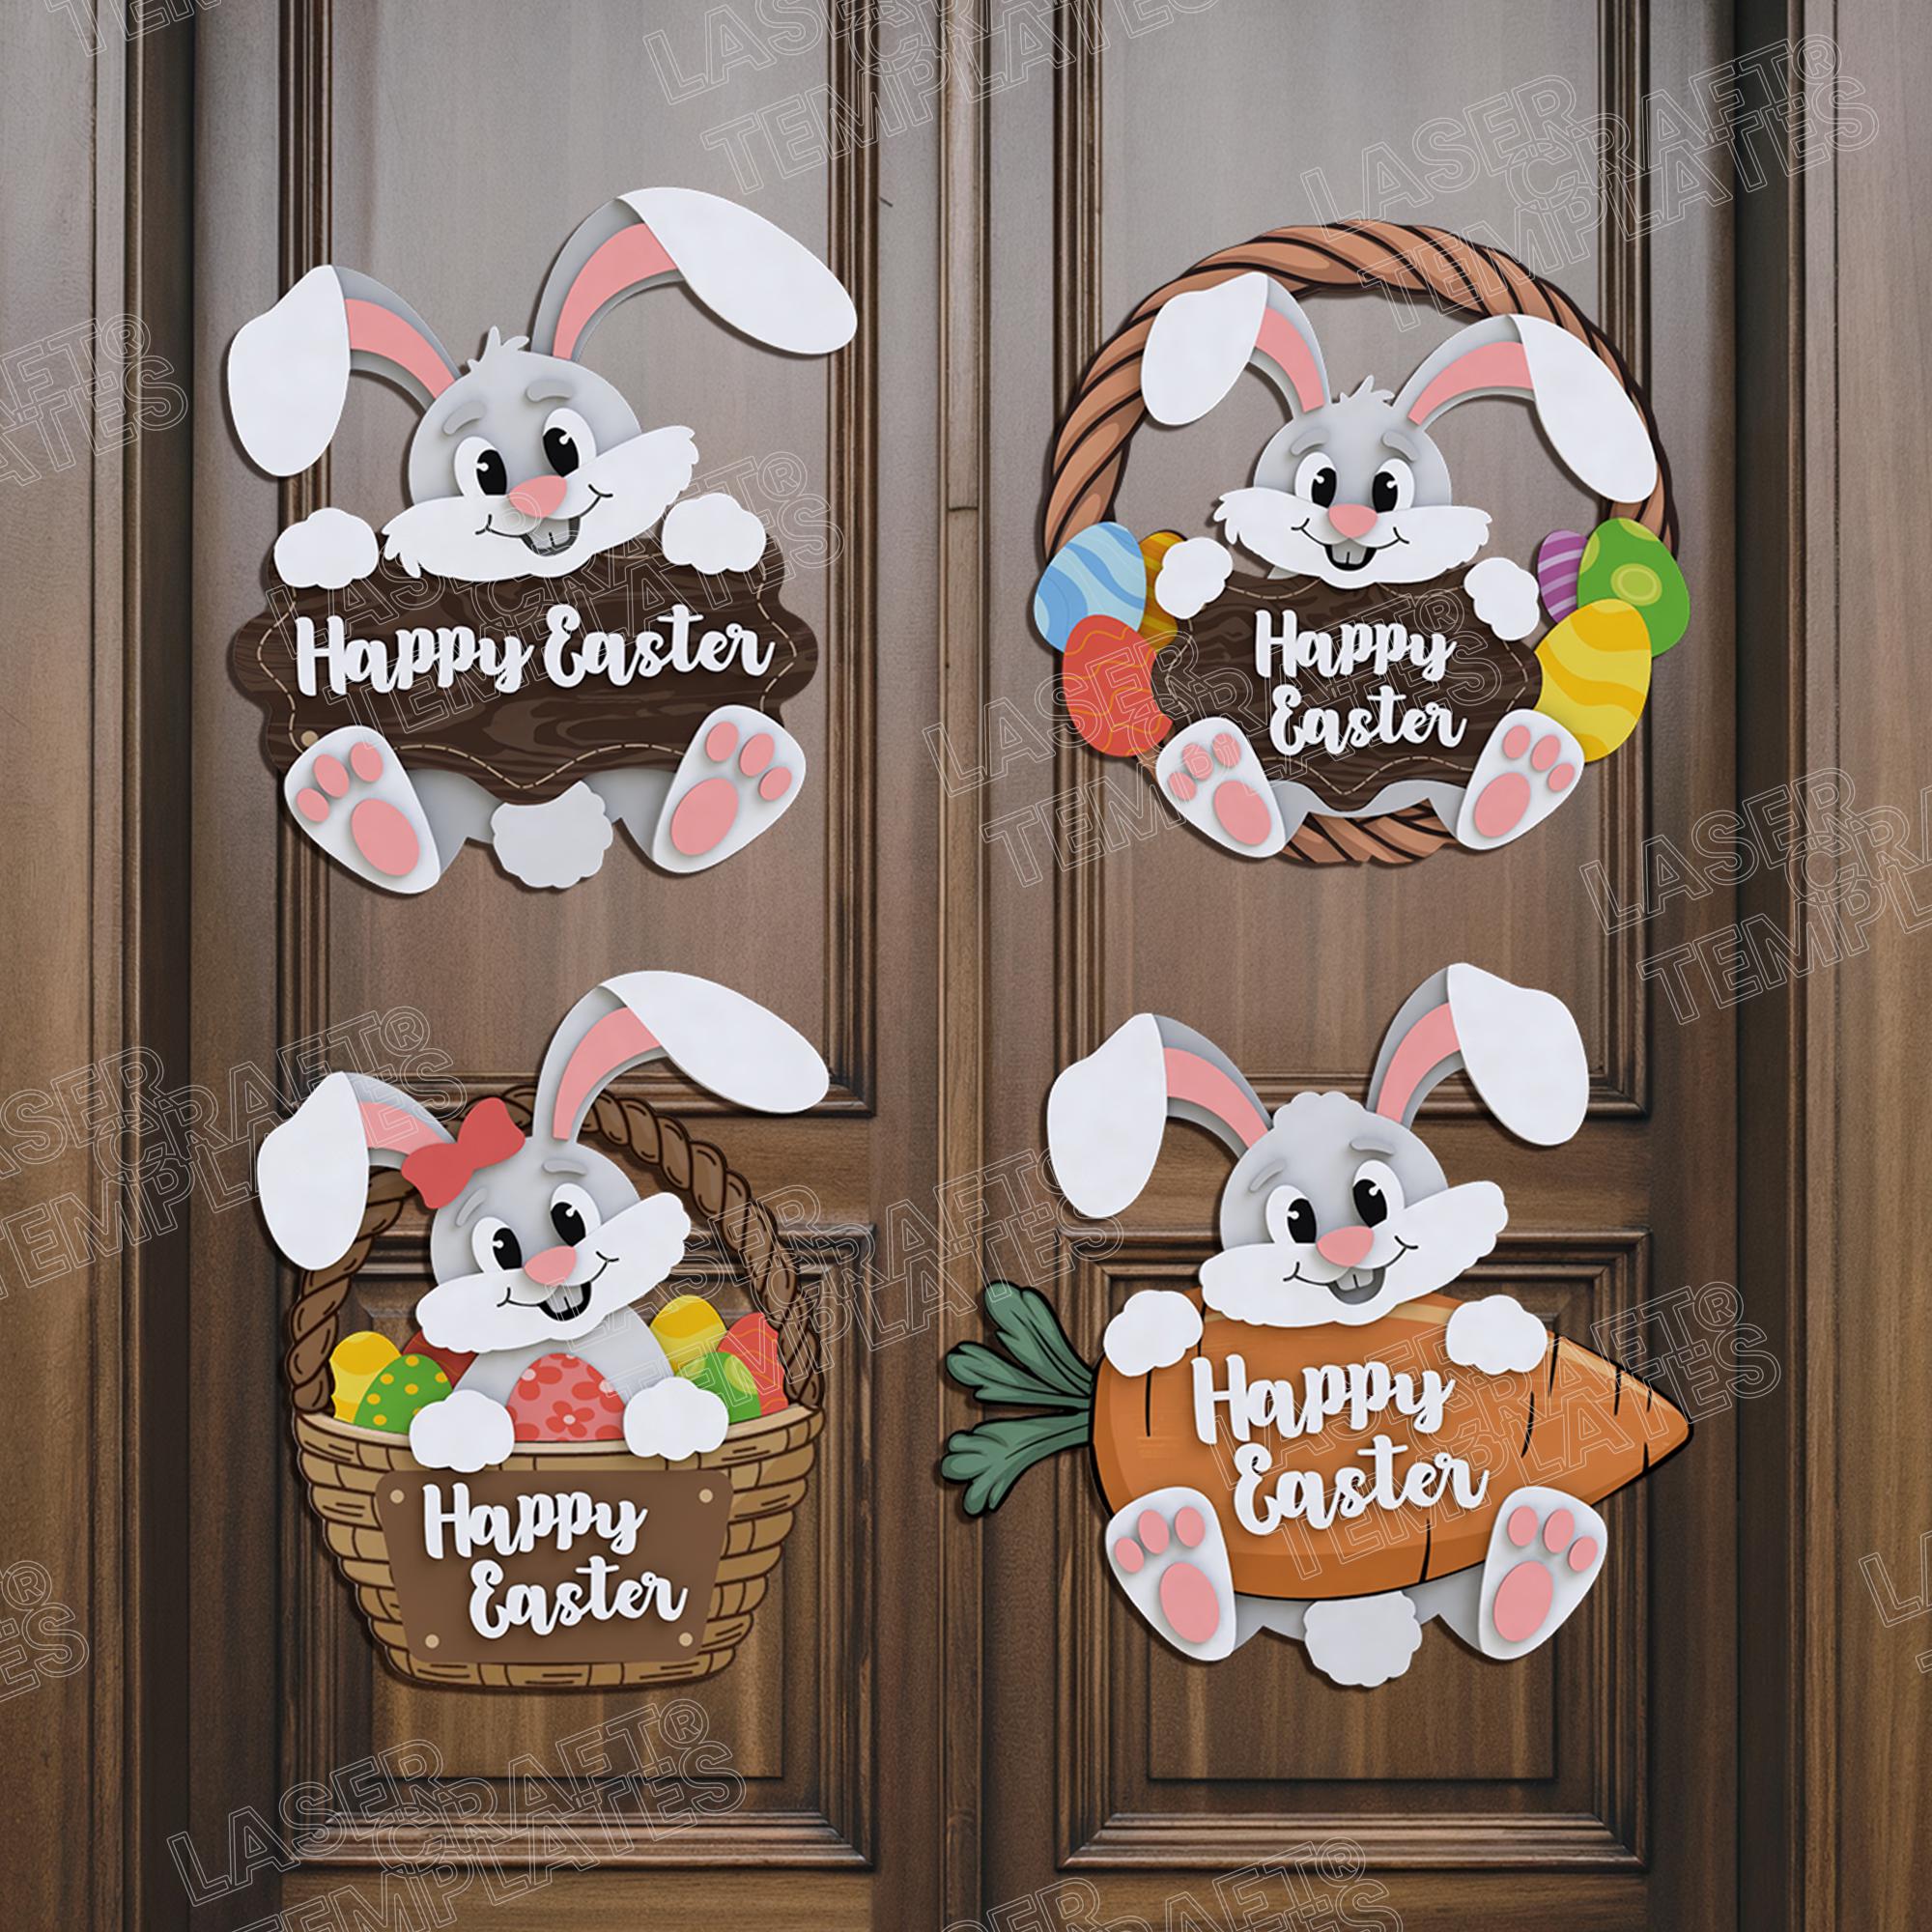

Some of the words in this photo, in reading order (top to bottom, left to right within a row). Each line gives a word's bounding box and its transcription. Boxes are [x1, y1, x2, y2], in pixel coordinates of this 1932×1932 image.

[296, 615, 533, 696] Happy
[543, 604, 776, 688] Easter
[1255, 610, 1457, 681] Happy
[1269, 684, 1467, 755] Easter
[1190, 1353, 1456, 1445] Happy
[422, 1482, 648, 1559] Happy
[1234, 1435, 1490, 1535] Easter
[469, 1555, 688, 1639] Easter
